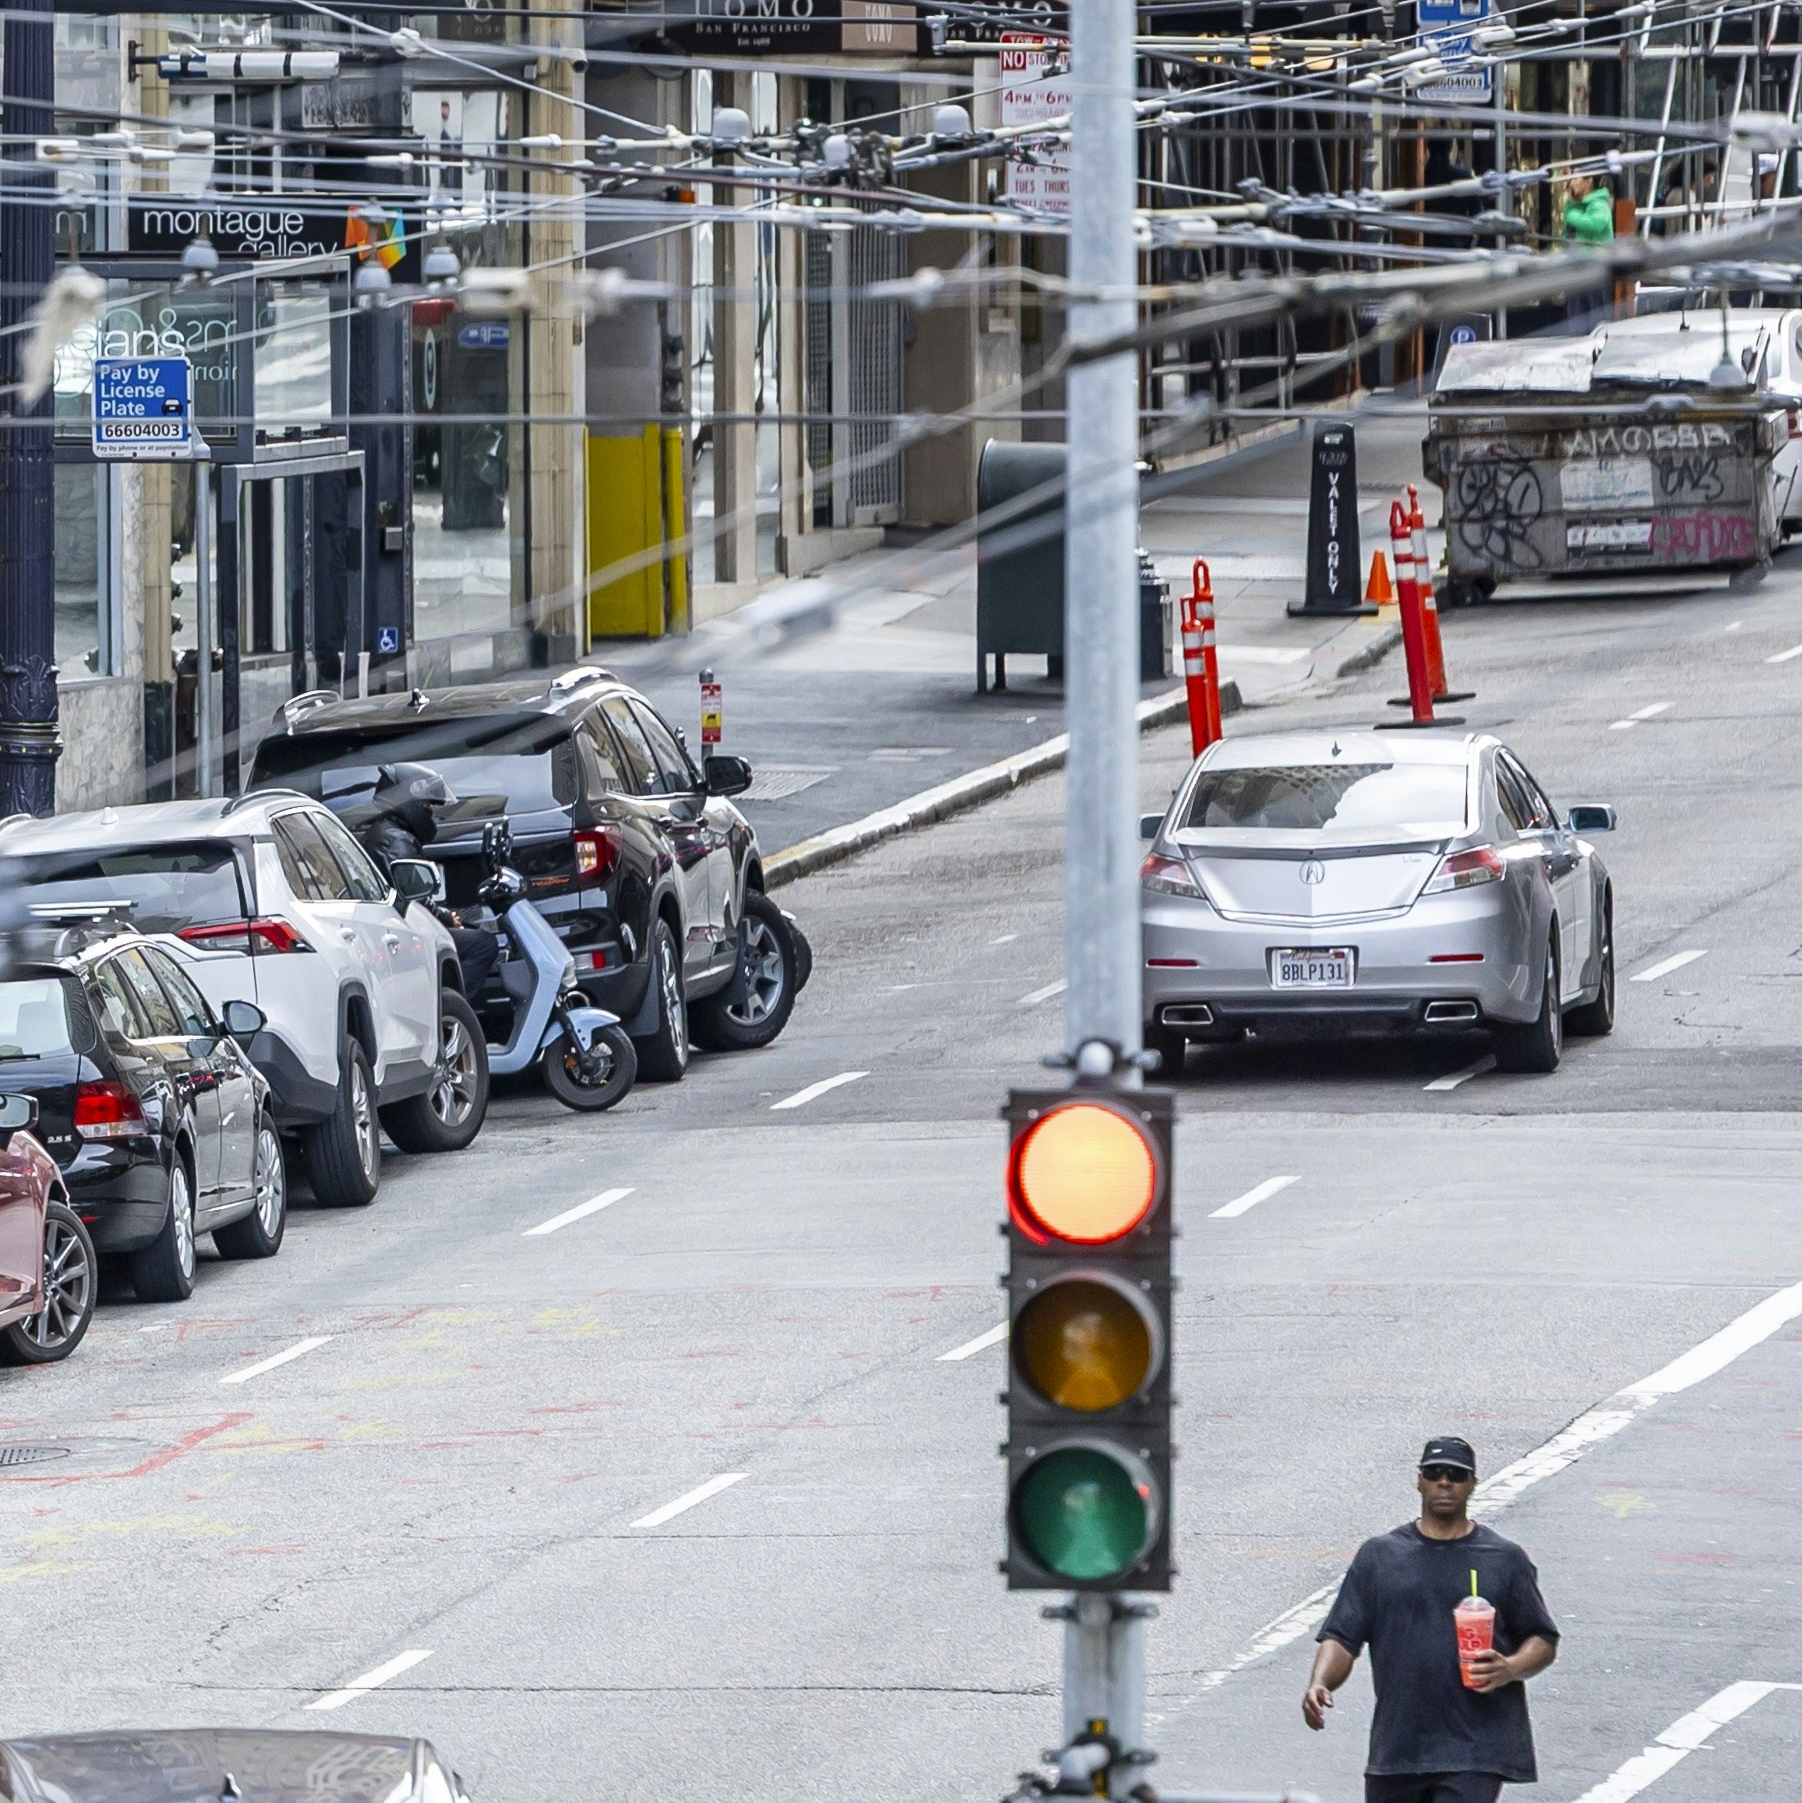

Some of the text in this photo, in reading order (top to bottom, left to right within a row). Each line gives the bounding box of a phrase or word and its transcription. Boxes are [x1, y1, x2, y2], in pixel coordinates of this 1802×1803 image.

[1003, 51, 1025, 69] NO
[144, 209, 304, 241] montague
[100, 364, 160, 384] Pay by
[101, 382, 166, 399] License
[101, 400, 145, 417] Plate
[104, 424, 180, 438] 66604003
[1328, 471, 1340, 538] VALET
[1327, 540, 1340, 595] ONLY
[1282, 963, 1344, 981] 8BLP131
